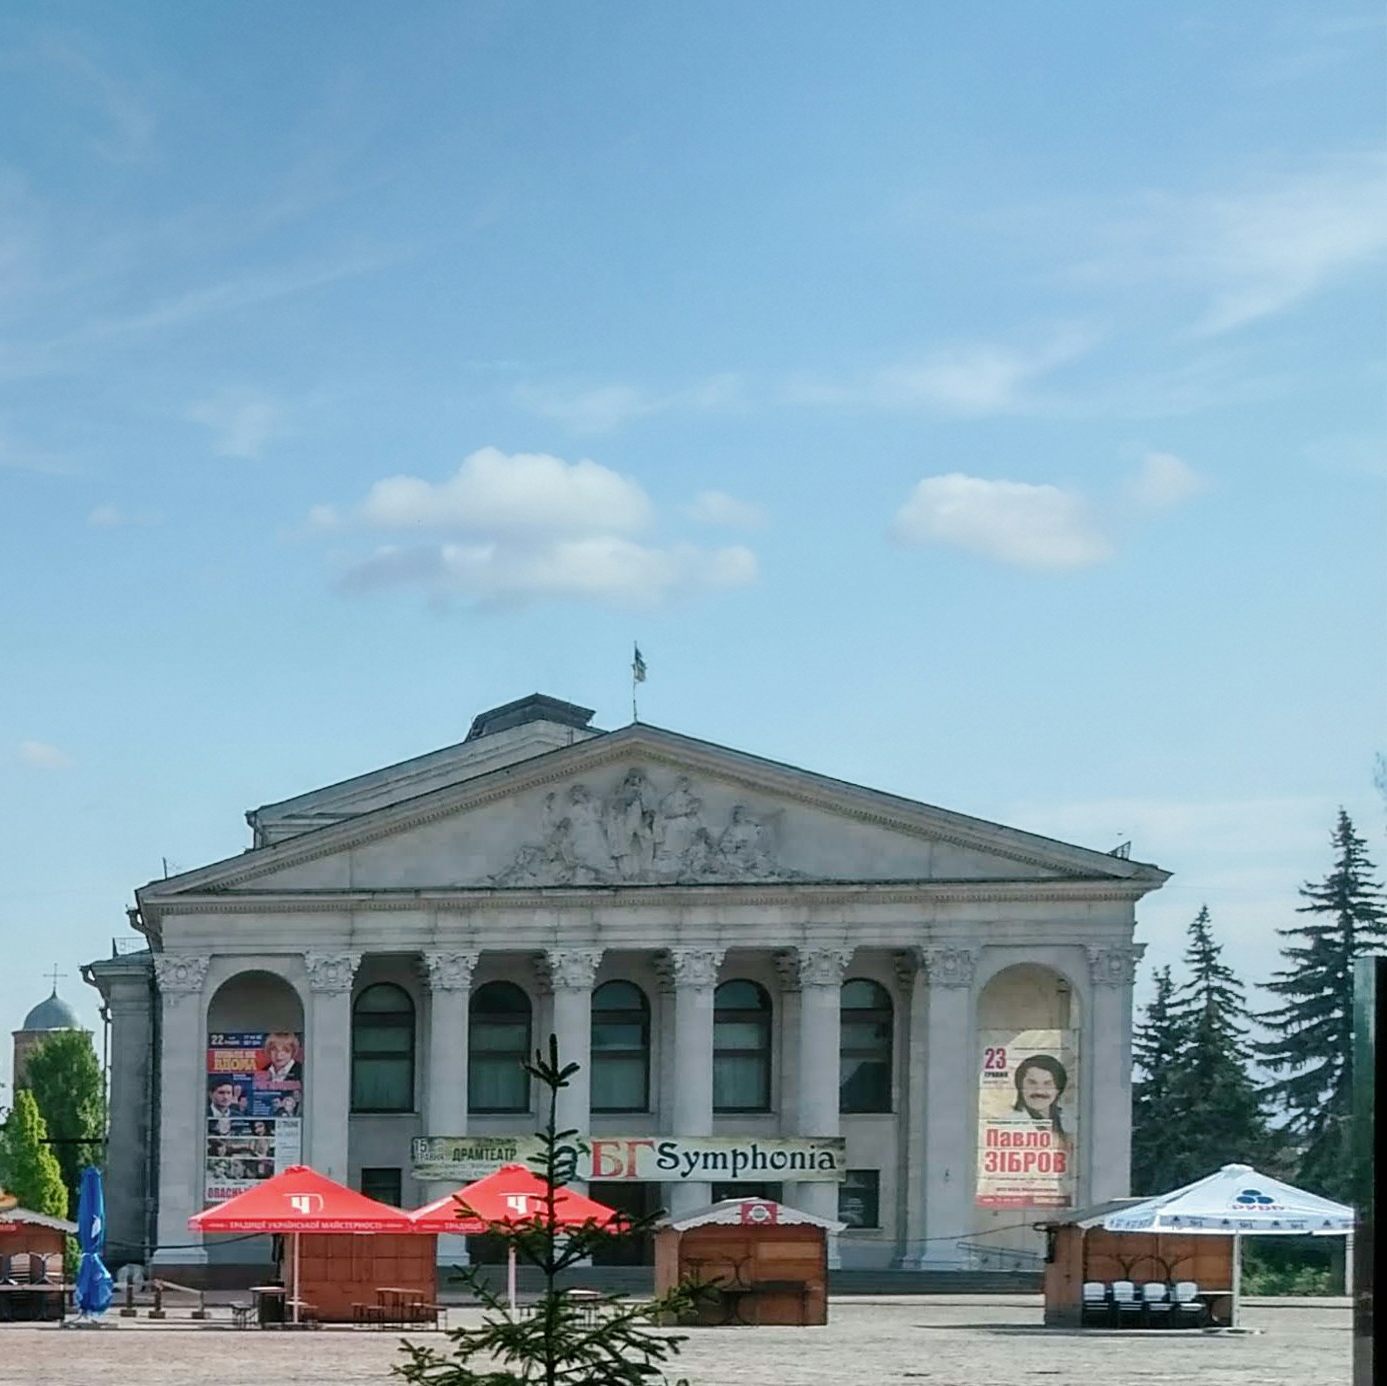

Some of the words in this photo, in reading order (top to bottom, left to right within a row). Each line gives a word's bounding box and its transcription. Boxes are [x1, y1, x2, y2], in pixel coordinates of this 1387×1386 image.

[211, 1034, 224, 1046] 22
[985, 1048, 1006, 1069] 23
[413, 1140, 427, 1153] 15
[986, 1129, 1051, 1147] Павло
[452, 1148, 517, 1162] ДРАМТЕАТР
[591, 1140, 656, 1179] БГ
[656, 1142, 837, 1179] Symphonia
[984, 1151, 1067, 1173] ЗІБРОВ
